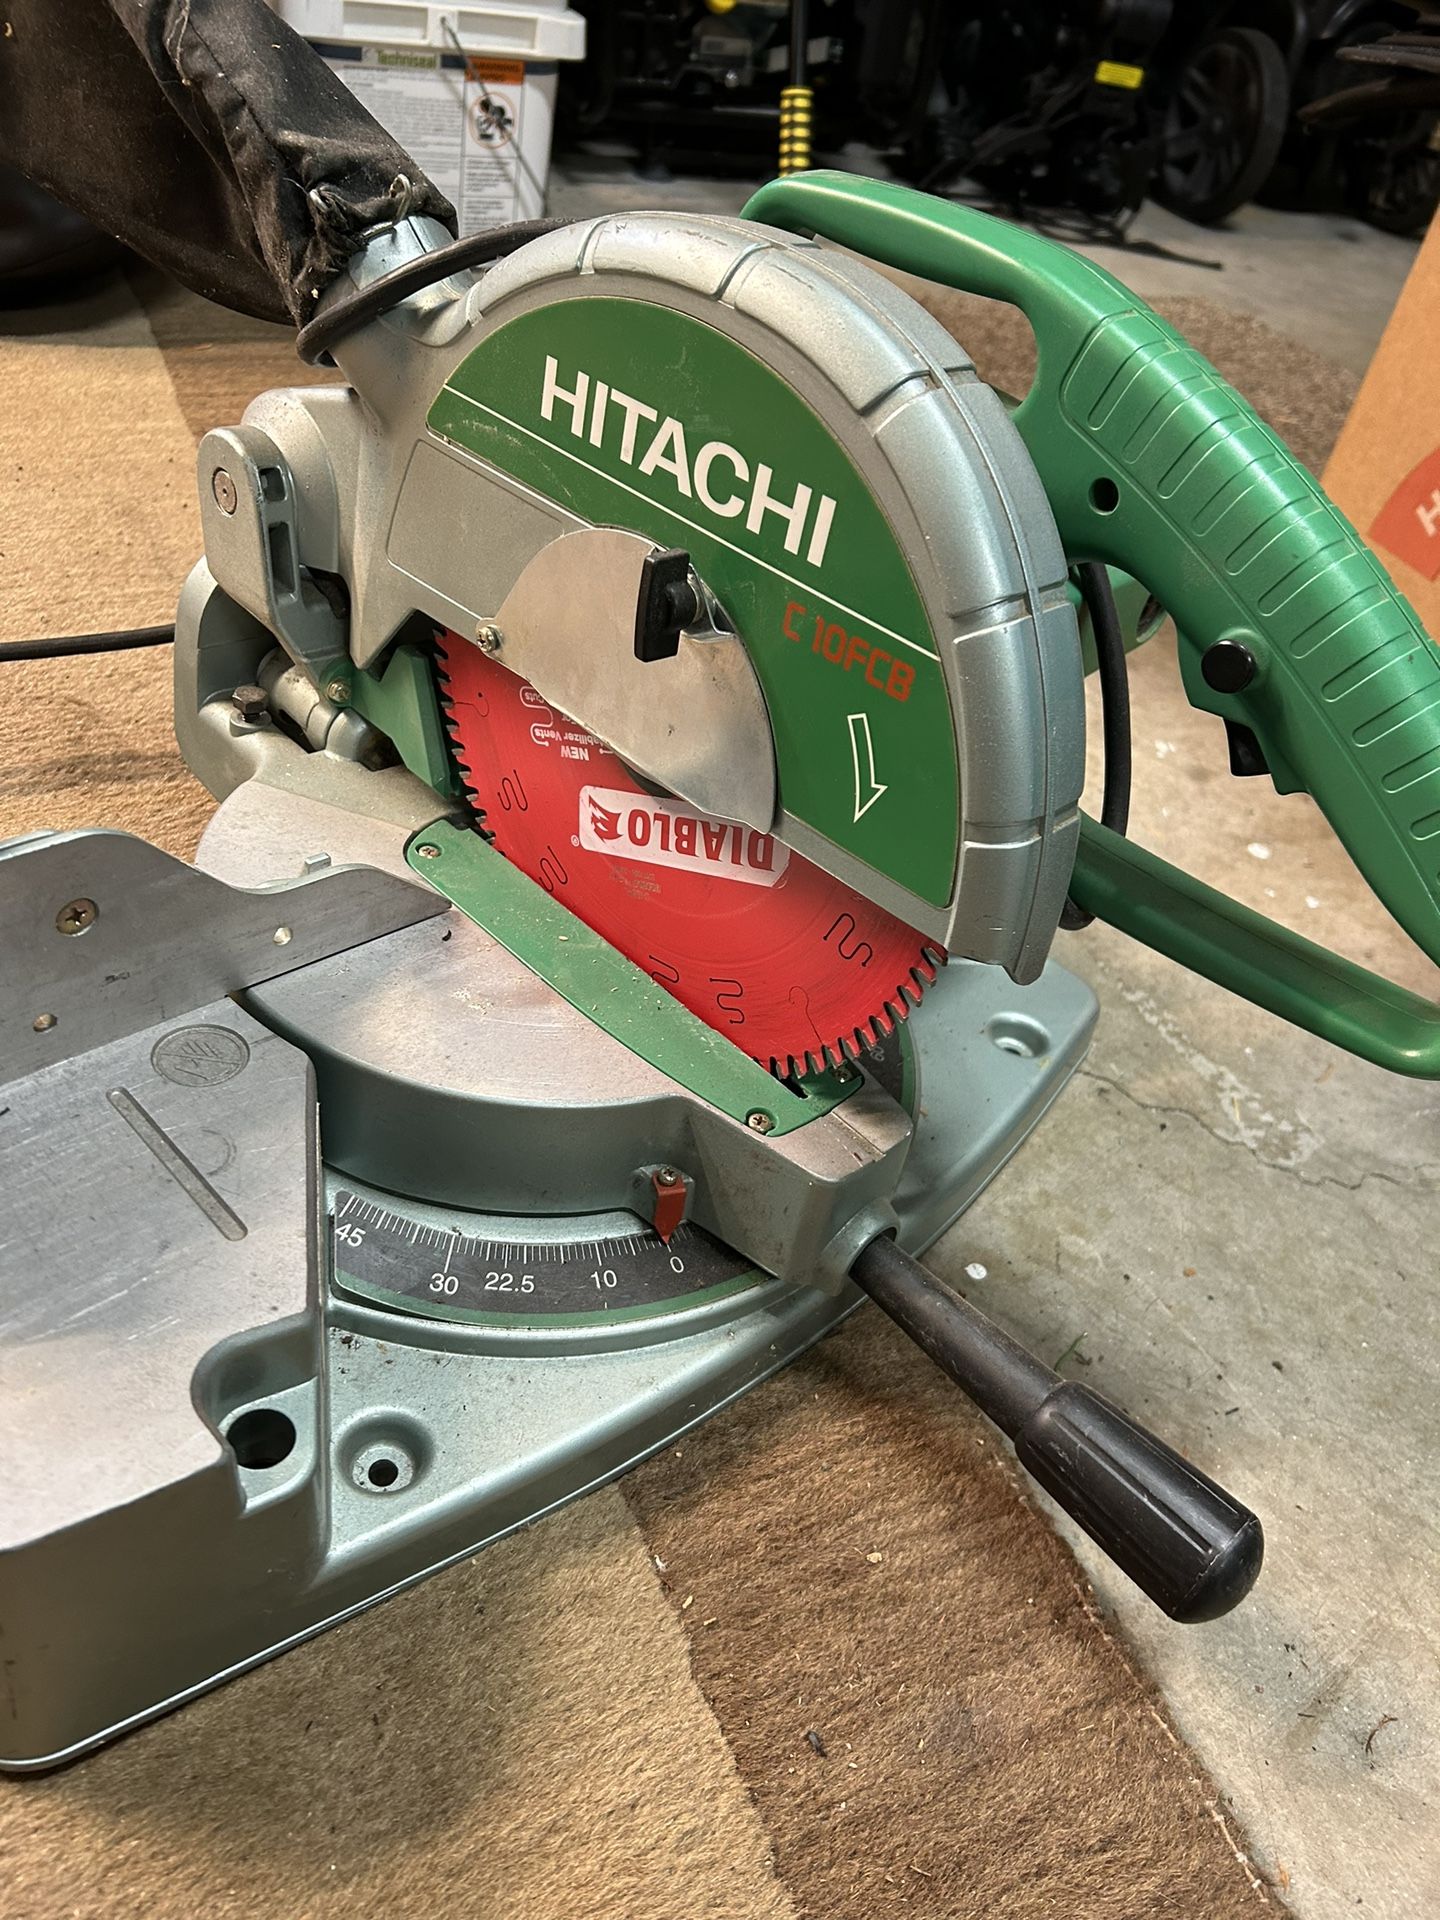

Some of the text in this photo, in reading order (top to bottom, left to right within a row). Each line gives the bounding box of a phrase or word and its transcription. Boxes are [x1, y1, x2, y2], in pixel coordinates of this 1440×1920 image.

[540, 354, 837, 568] HITACHI
[782, 601, 917, 702] C 10FCB
[534, 728, 604, 747] tabilizer Vents
[560, 745, 590, 761] NEW
[627, 808, 776, 873] DIABLO
[334, 1222, 685, 1296] 45 30 22.5 10 0
